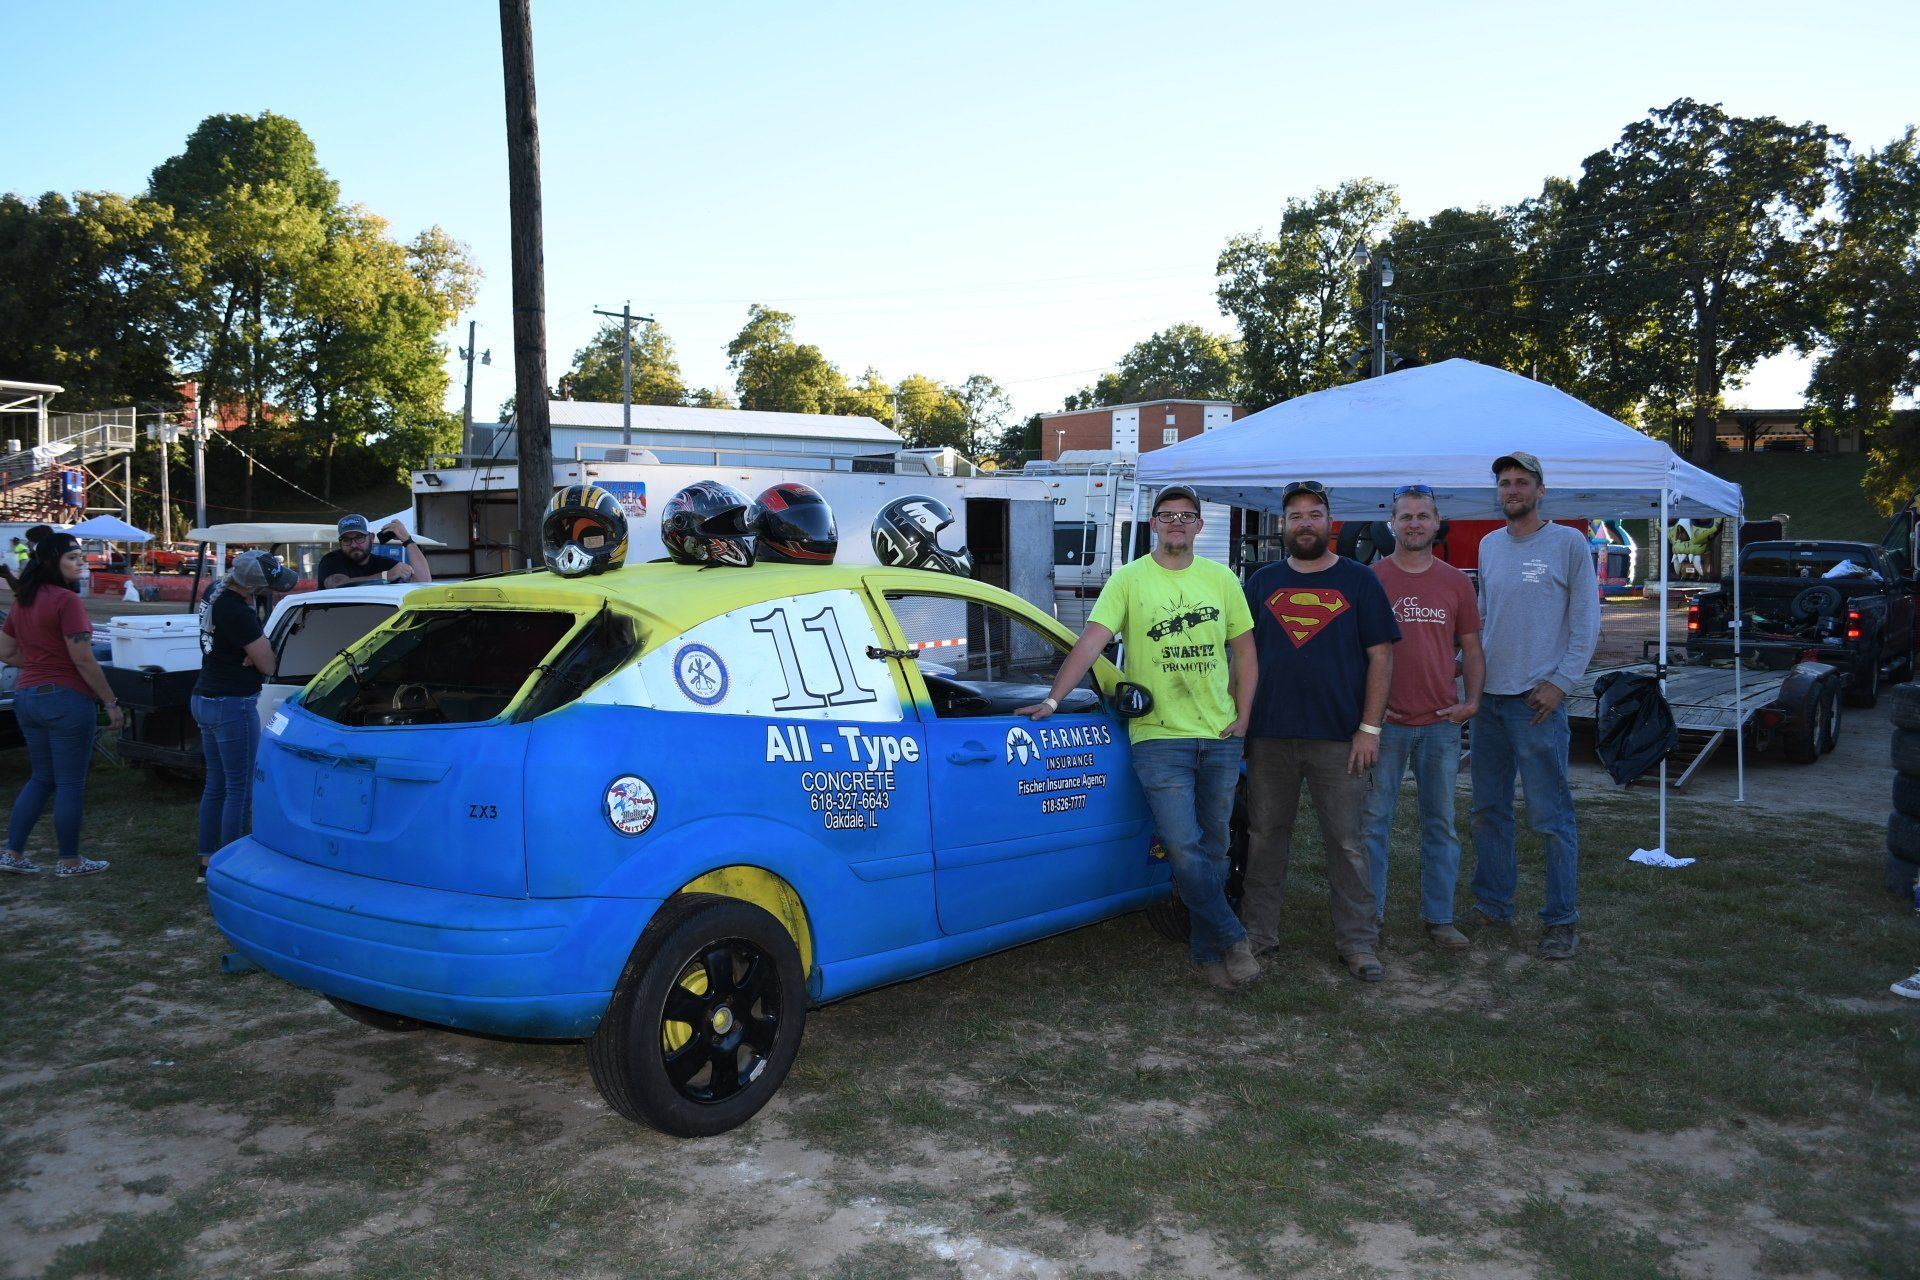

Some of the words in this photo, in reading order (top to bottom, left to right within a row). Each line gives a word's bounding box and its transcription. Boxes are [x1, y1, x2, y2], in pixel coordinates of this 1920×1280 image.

[1403, 596, 1418, 607] CC
[1403, 607, 1446, 619] STRONG
[749, 606, 877, 711] 11
[1162, 644, 1215, 659] SWARTZ
[1039, 725, 1111, 750] FARMERS
[766, 725, 813, 762] All
[837, 726, 920, 772] Type
[1046, 753, 1094, 770] INSURANCE
[801, 771, 896, 791] CONCRETE
[1018, 779, 1046, 795] Fischer
[1047, 776, 1081, 791] Insurance
[1082, 773, 1107, 789] Agency
[811, 791, 889, 811] 618-327-6643
[1042, 794, 1087, 814] 618-526-7777
[469, 804, 498, 819] ZX3
[824, 810, 866, 829] Oakdale,
[869, 811, 878, 827] IL
[615, 813, 653, 832] IGNITION
